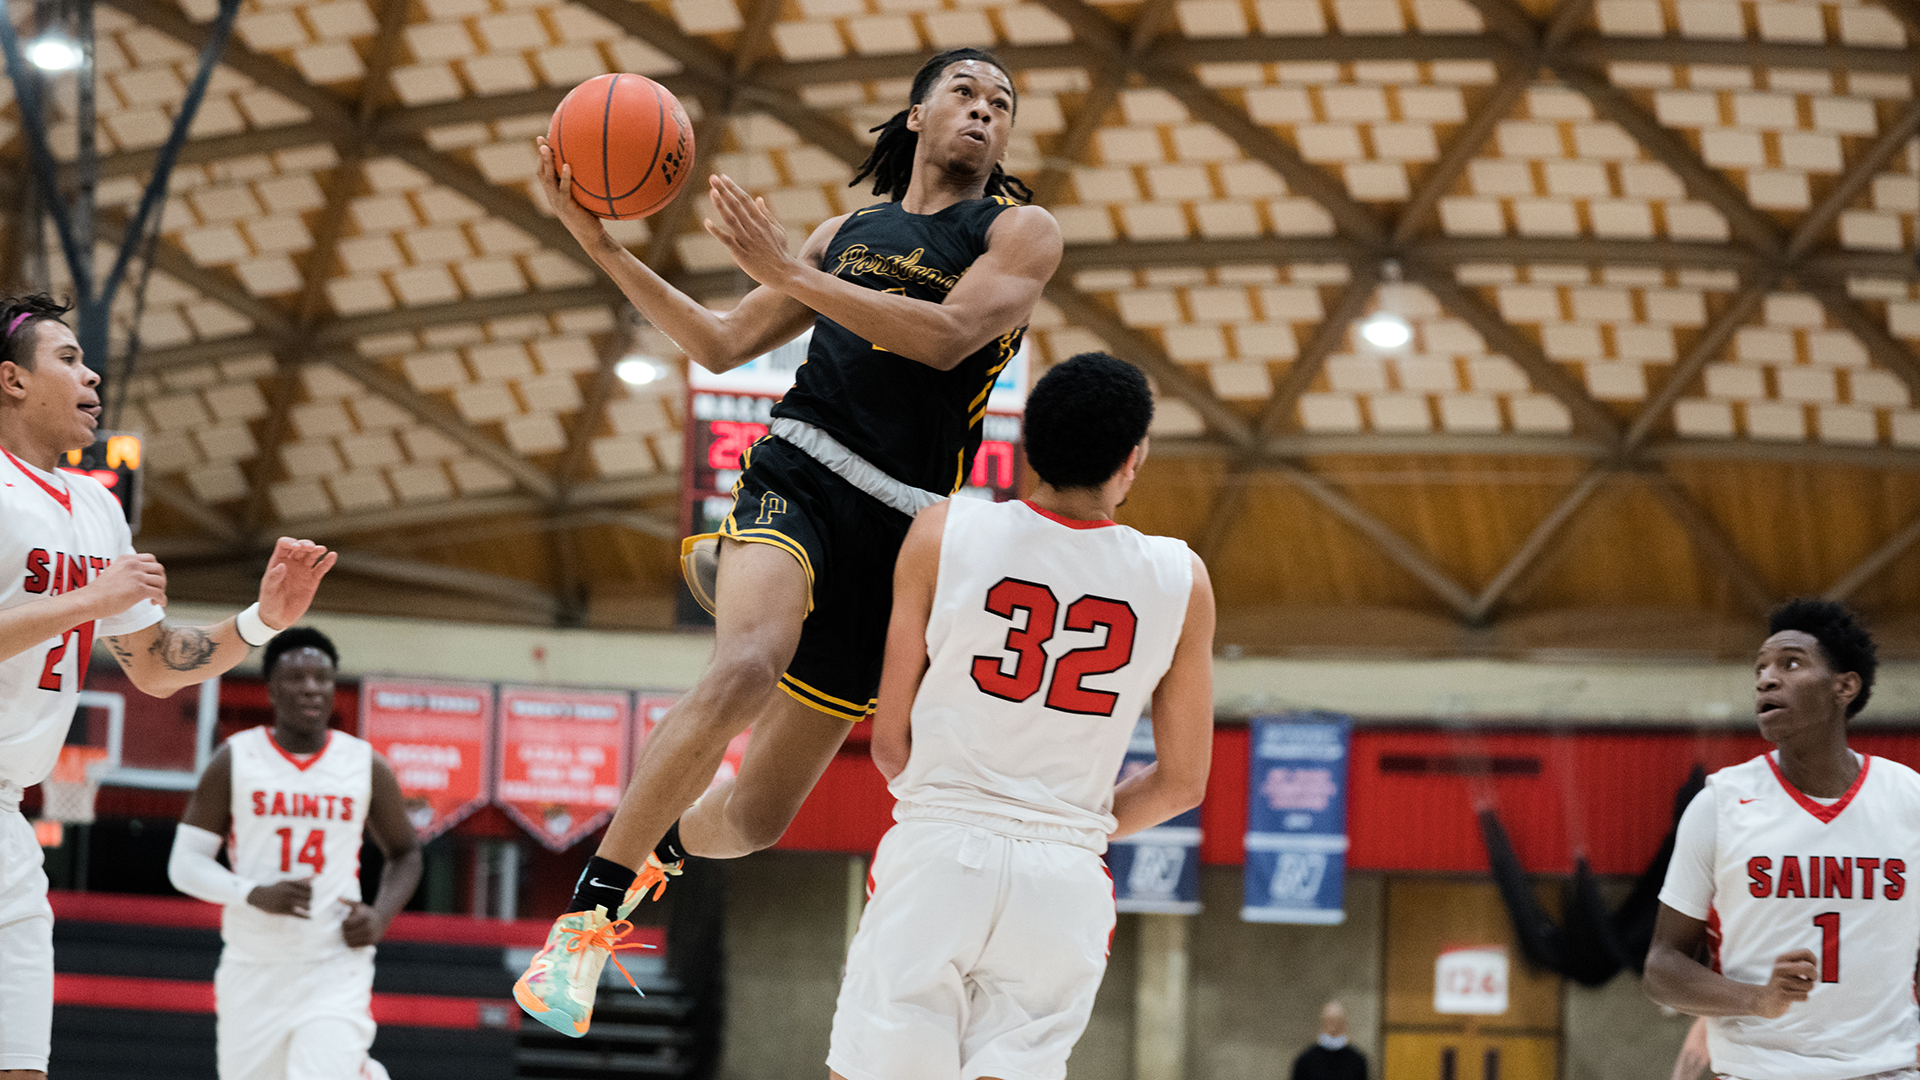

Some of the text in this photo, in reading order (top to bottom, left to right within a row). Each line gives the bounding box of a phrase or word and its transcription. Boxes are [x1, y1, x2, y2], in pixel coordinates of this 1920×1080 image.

[755, 490, 787, 524] P
[970, 576, 1138, 718] 32
[252, 790, 354, 821] SAINTS
[276, 827, 326, 874] 14
[1746, 855, 1907, 901] SAINTS
[1813, 911, 1841, 984] 1
